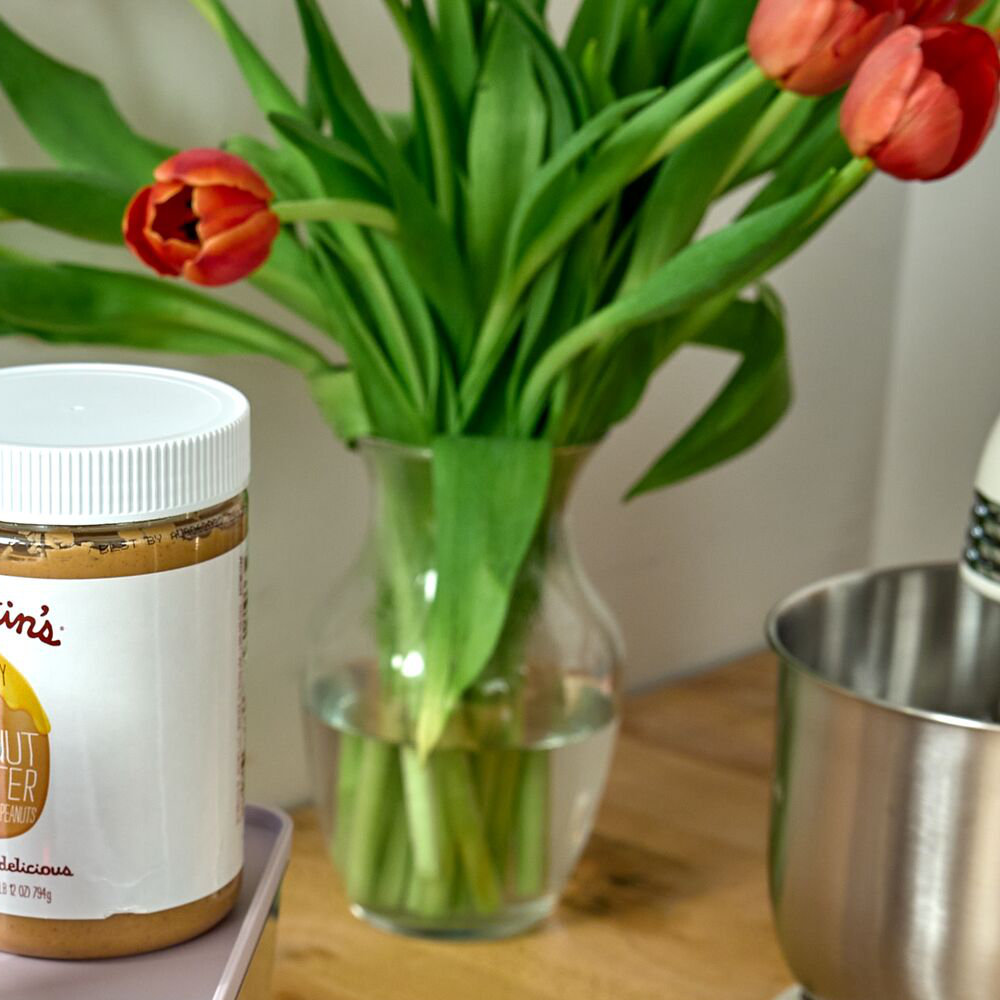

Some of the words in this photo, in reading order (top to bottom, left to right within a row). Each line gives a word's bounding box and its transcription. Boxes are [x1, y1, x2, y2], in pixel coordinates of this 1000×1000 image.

[0, 803, 37, 824] PEANUTS
[0, 881, 8, 895] LB
[10, 884, 17, 897] 12
[33, 886, 52, 904] 794g
